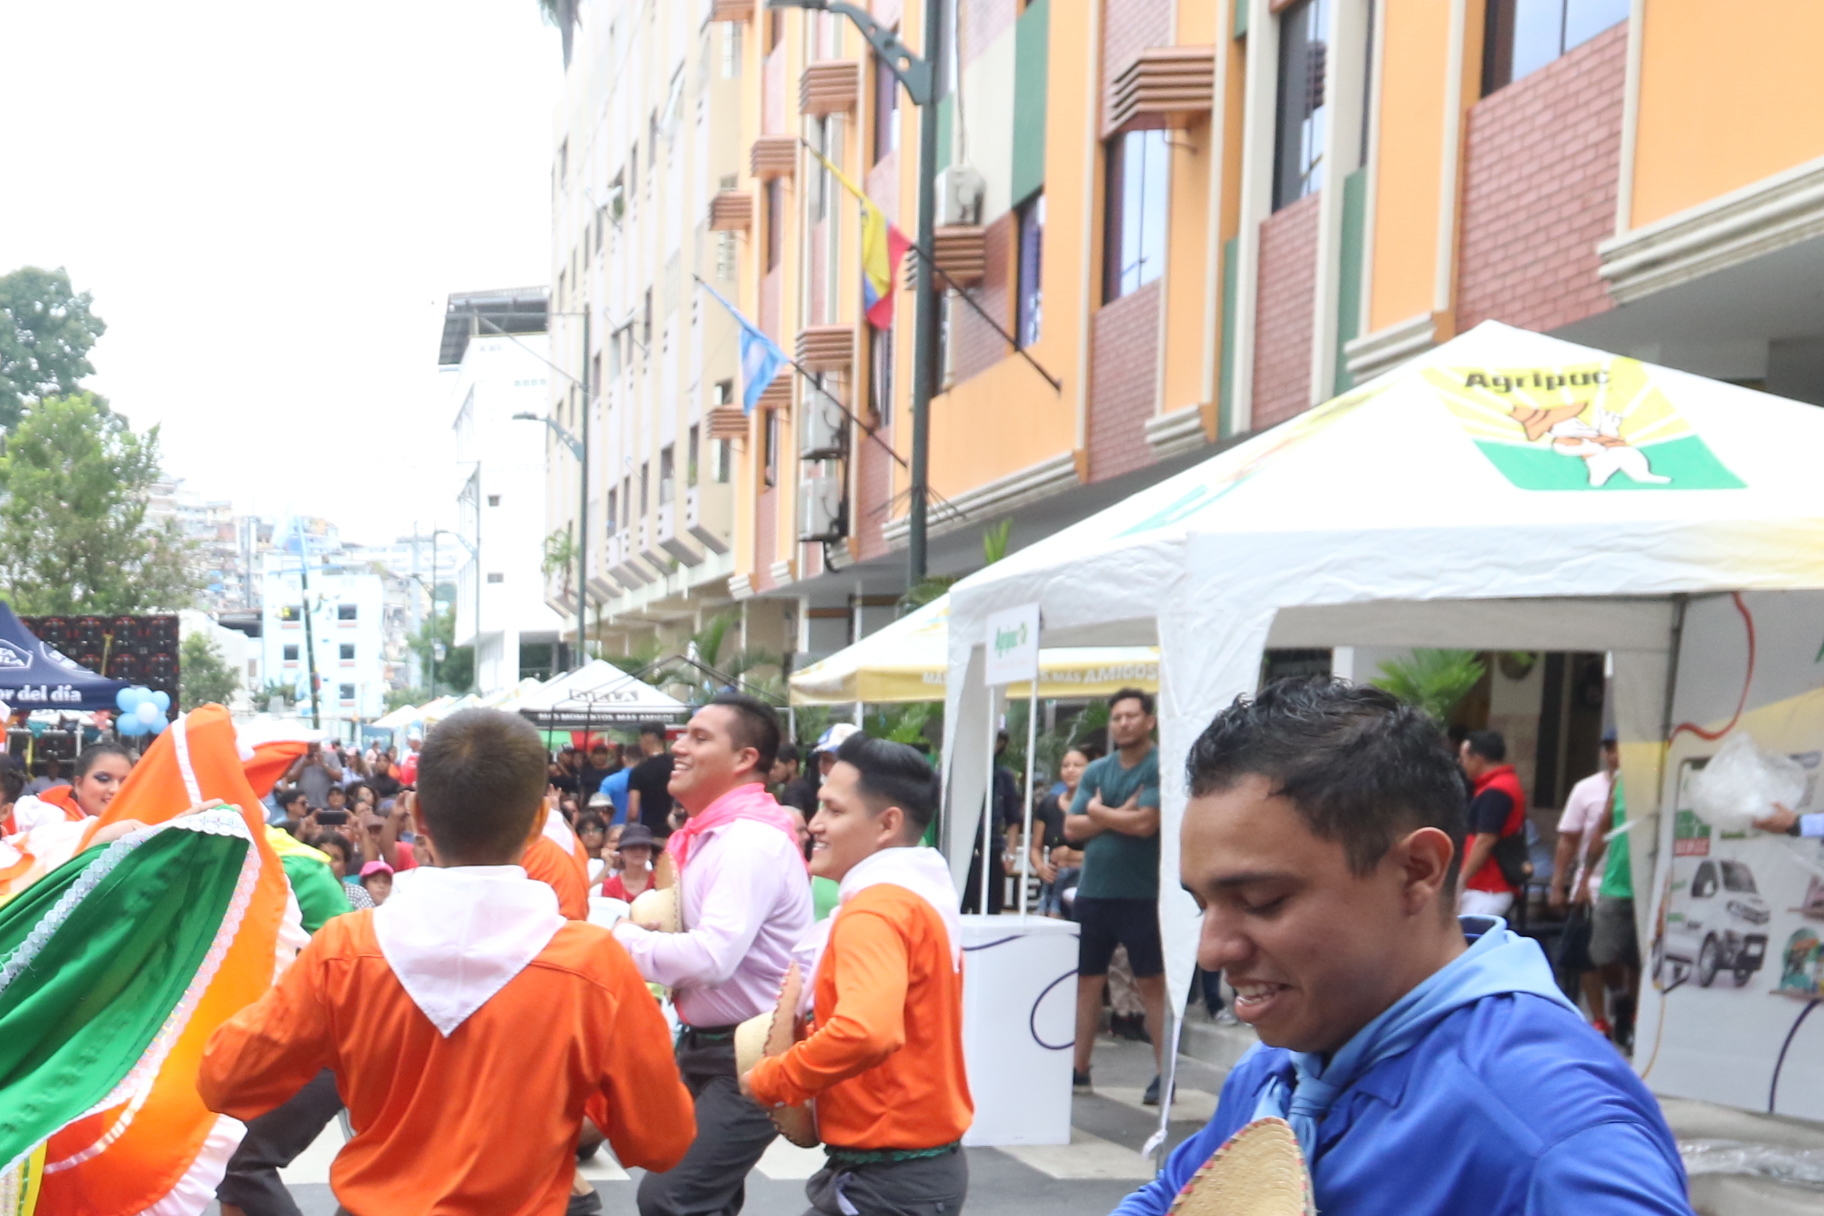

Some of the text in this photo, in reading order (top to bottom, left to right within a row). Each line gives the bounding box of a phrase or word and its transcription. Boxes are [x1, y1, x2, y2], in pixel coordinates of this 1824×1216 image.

[1084, 662, 1159, 684] AMIGOS
[17, 684, 47, 702] del
[50, 684, 82, 703] día
